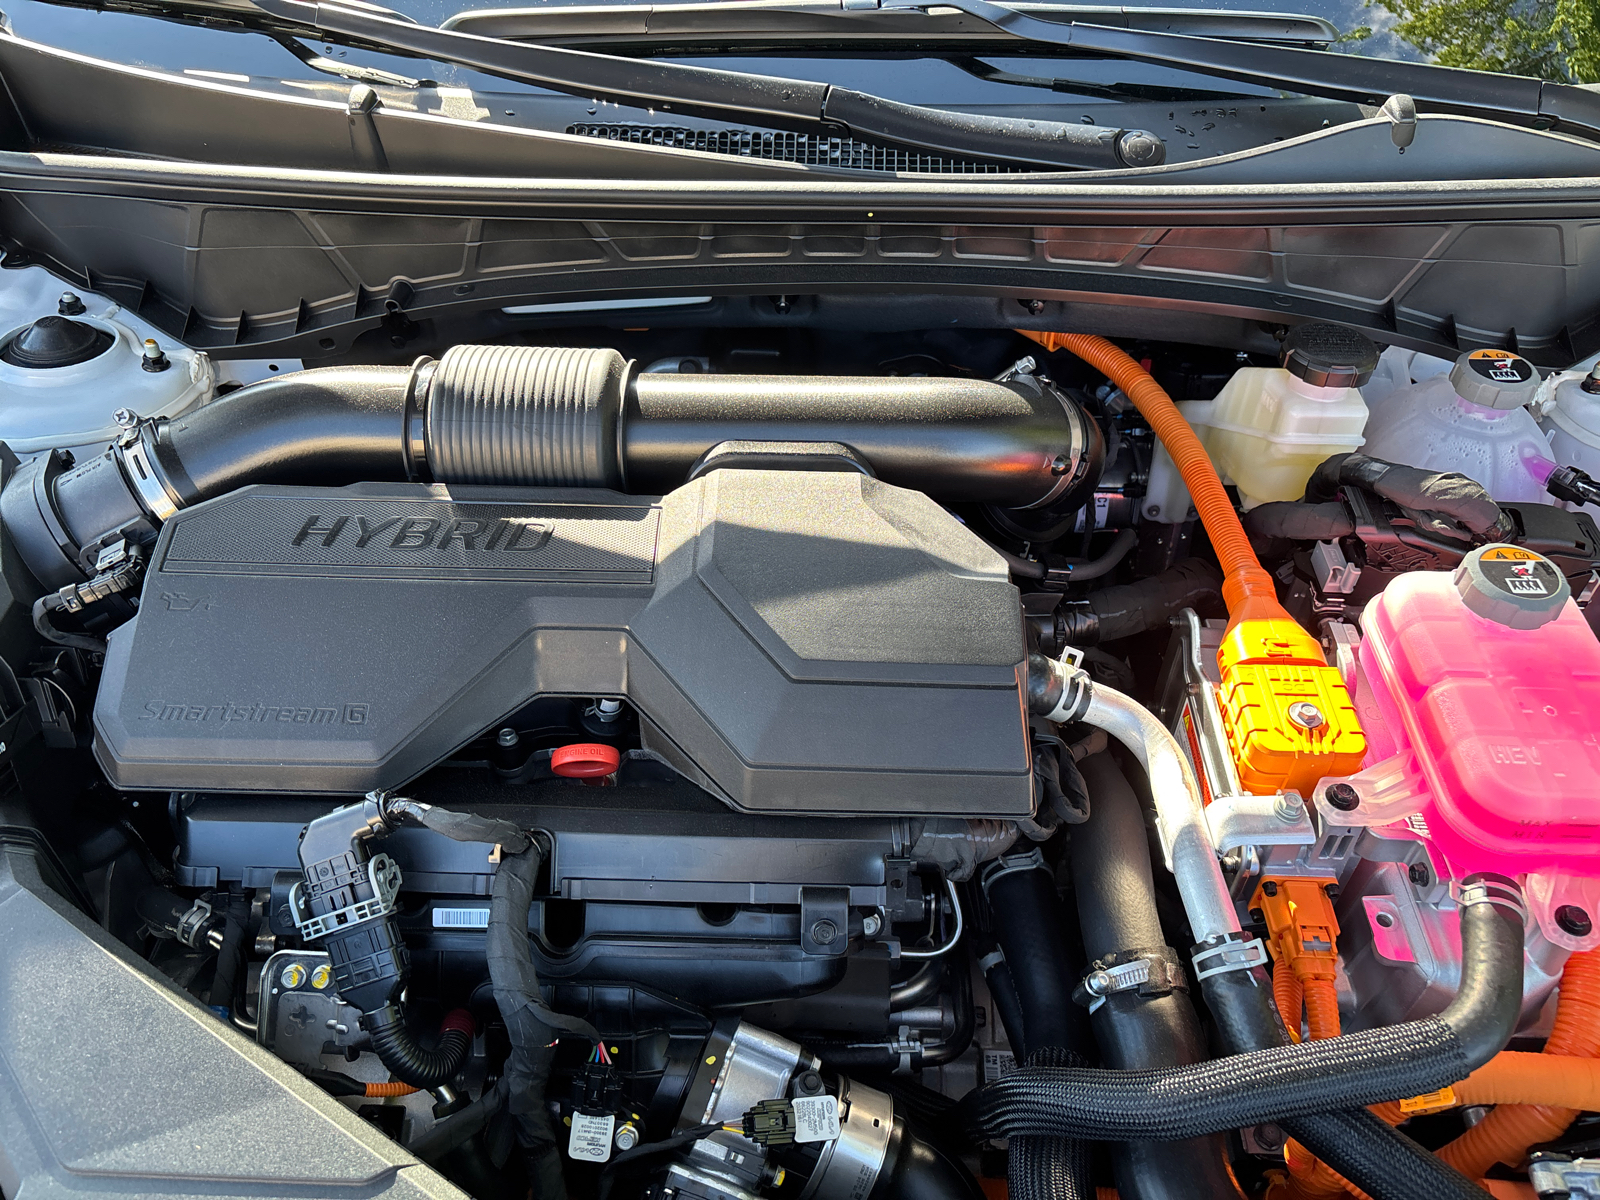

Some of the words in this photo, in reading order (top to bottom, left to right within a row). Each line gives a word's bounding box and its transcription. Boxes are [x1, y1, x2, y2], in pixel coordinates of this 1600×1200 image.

[291, 514, 556, 552] HYBRID
[137, 699, 338, 729] Smartstream
[342, 702, 370, 725] G
[560, 747, 588, 758] ENGINE
[590, 746, 604, 756] OIL
[1488, 744, 1542, 767] HEV
[1520, 819, 1553, 828] MAX
[1511, 830, 1546, 839] MIN
